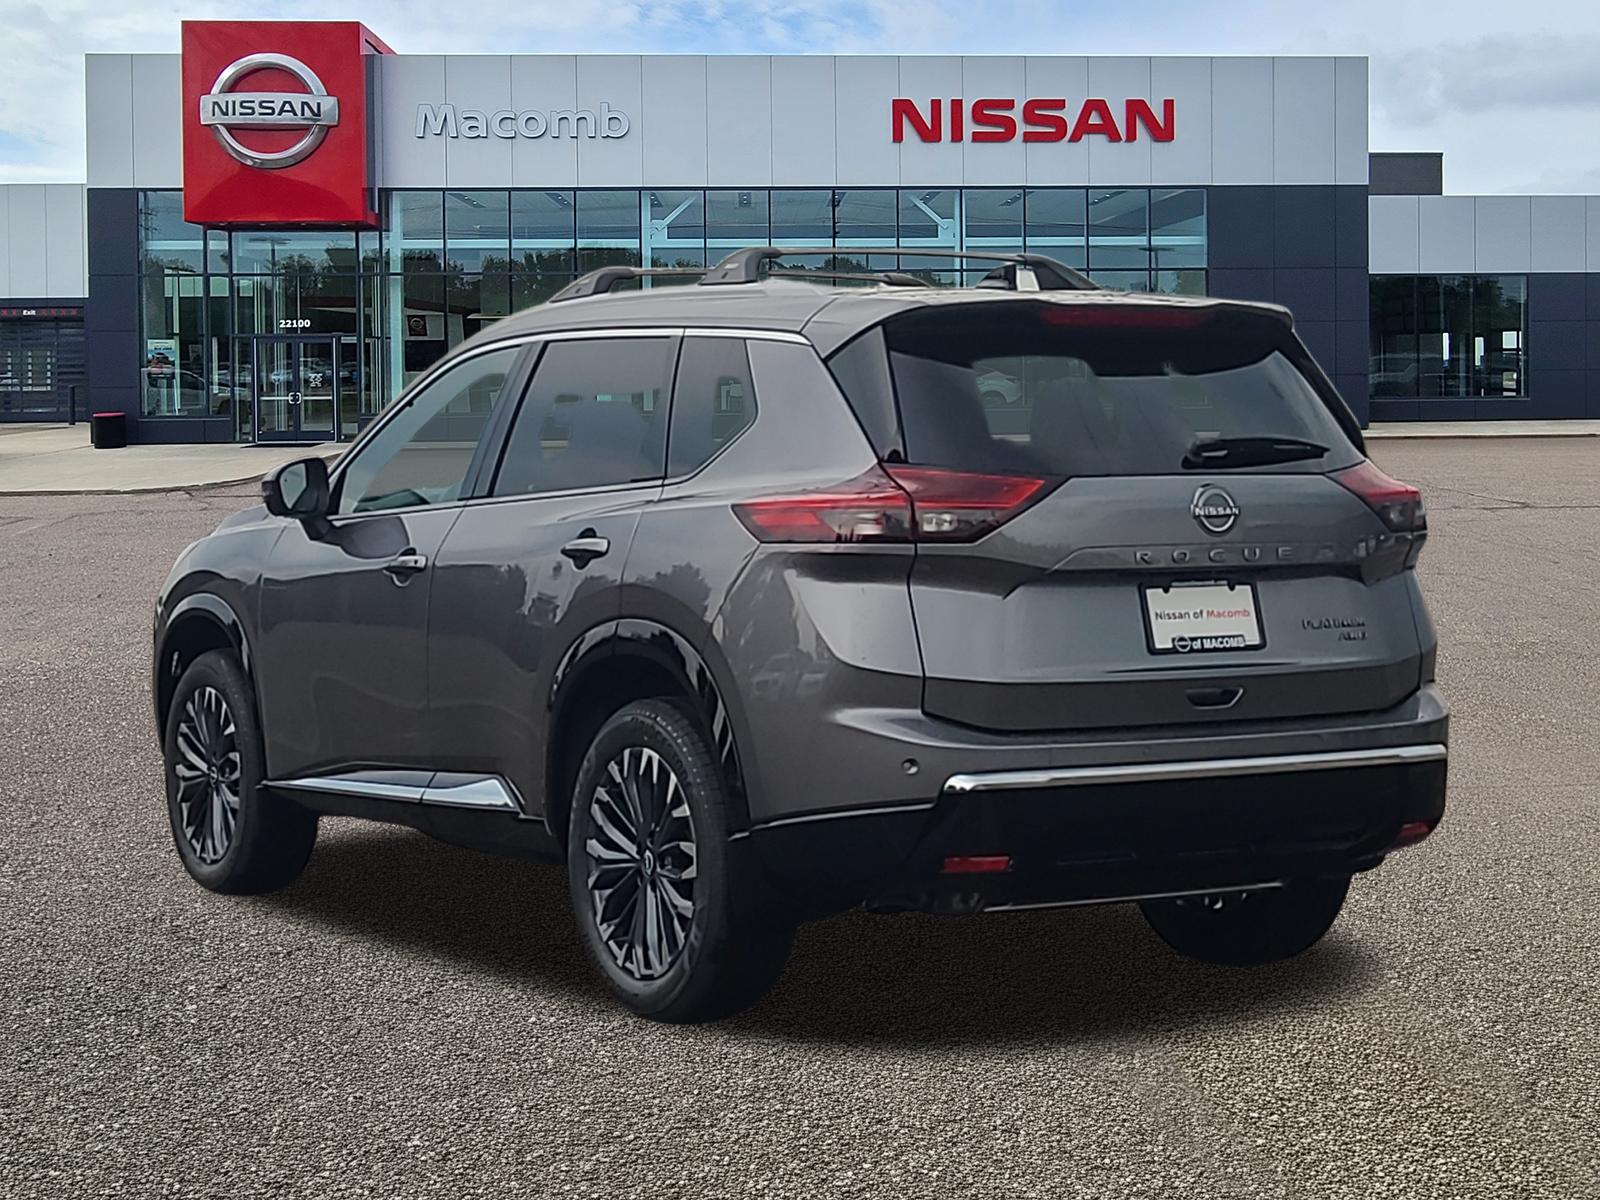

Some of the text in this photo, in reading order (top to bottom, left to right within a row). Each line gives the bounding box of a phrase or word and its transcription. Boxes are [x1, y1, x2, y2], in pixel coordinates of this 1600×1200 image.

[211, 100, 322, 117] NISSAN
[415, 102, 630, 139] Macomb
[892, 98, 1175, 143] NISSAN
[279, 319, 311, 328] 22100
[1194, 506, 1239, 516] NISSAN
[1134, 547, 1293, 564] ROGUE
[1154, 608, 1250, 621] Nissan of Macomb
[1192, 637, 1246, 649] of MACOMB
